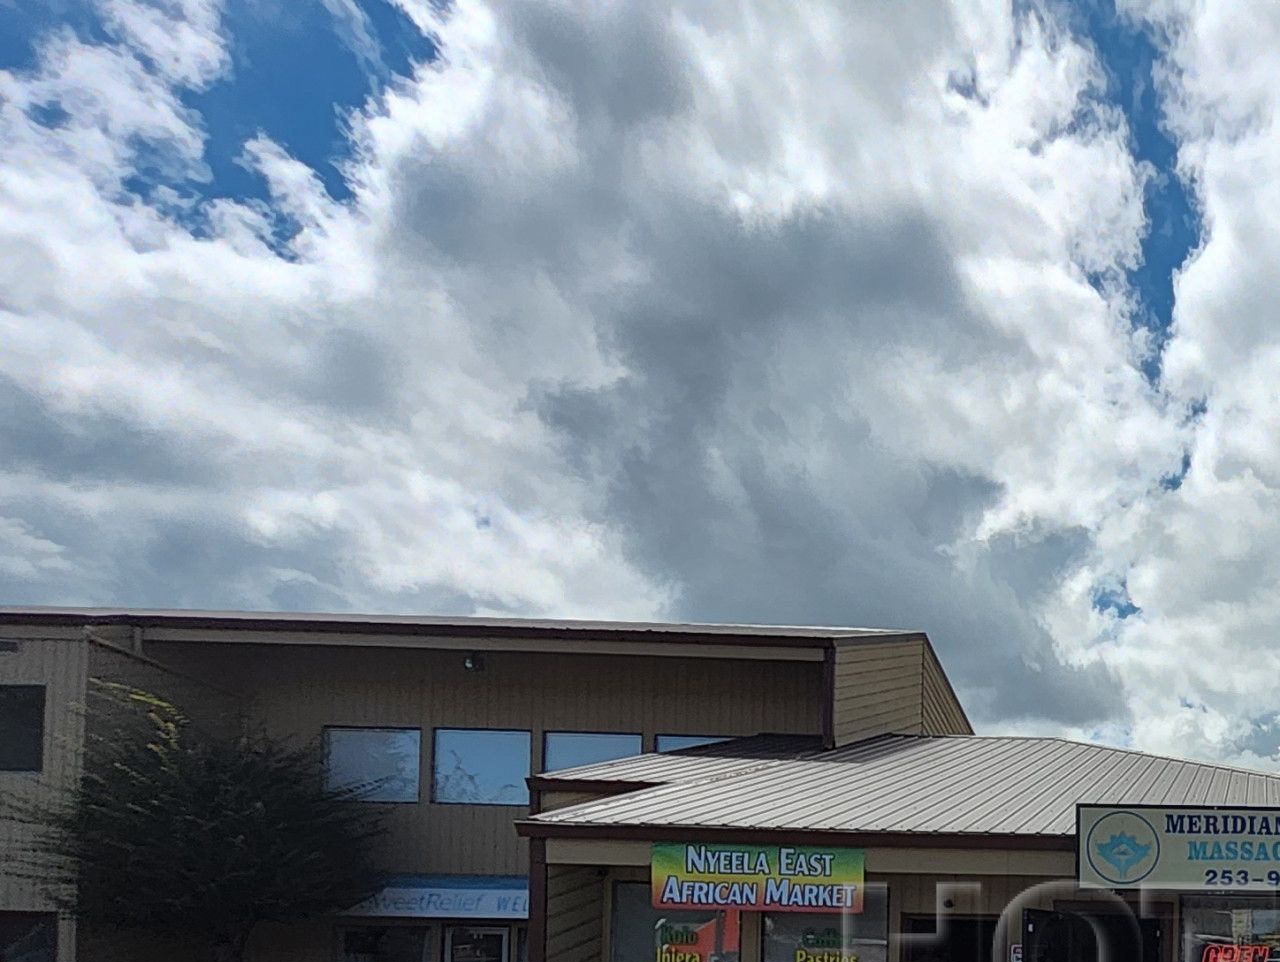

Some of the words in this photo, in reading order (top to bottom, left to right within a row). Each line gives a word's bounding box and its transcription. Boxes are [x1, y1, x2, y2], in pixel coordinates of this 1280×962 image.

[685, 845, 770, 875] NYEELA
[779, 848, 835, 877] EAST
[662, 875, 757, 905] AFRICAN
[765, 879, 857, 908] MARKET
